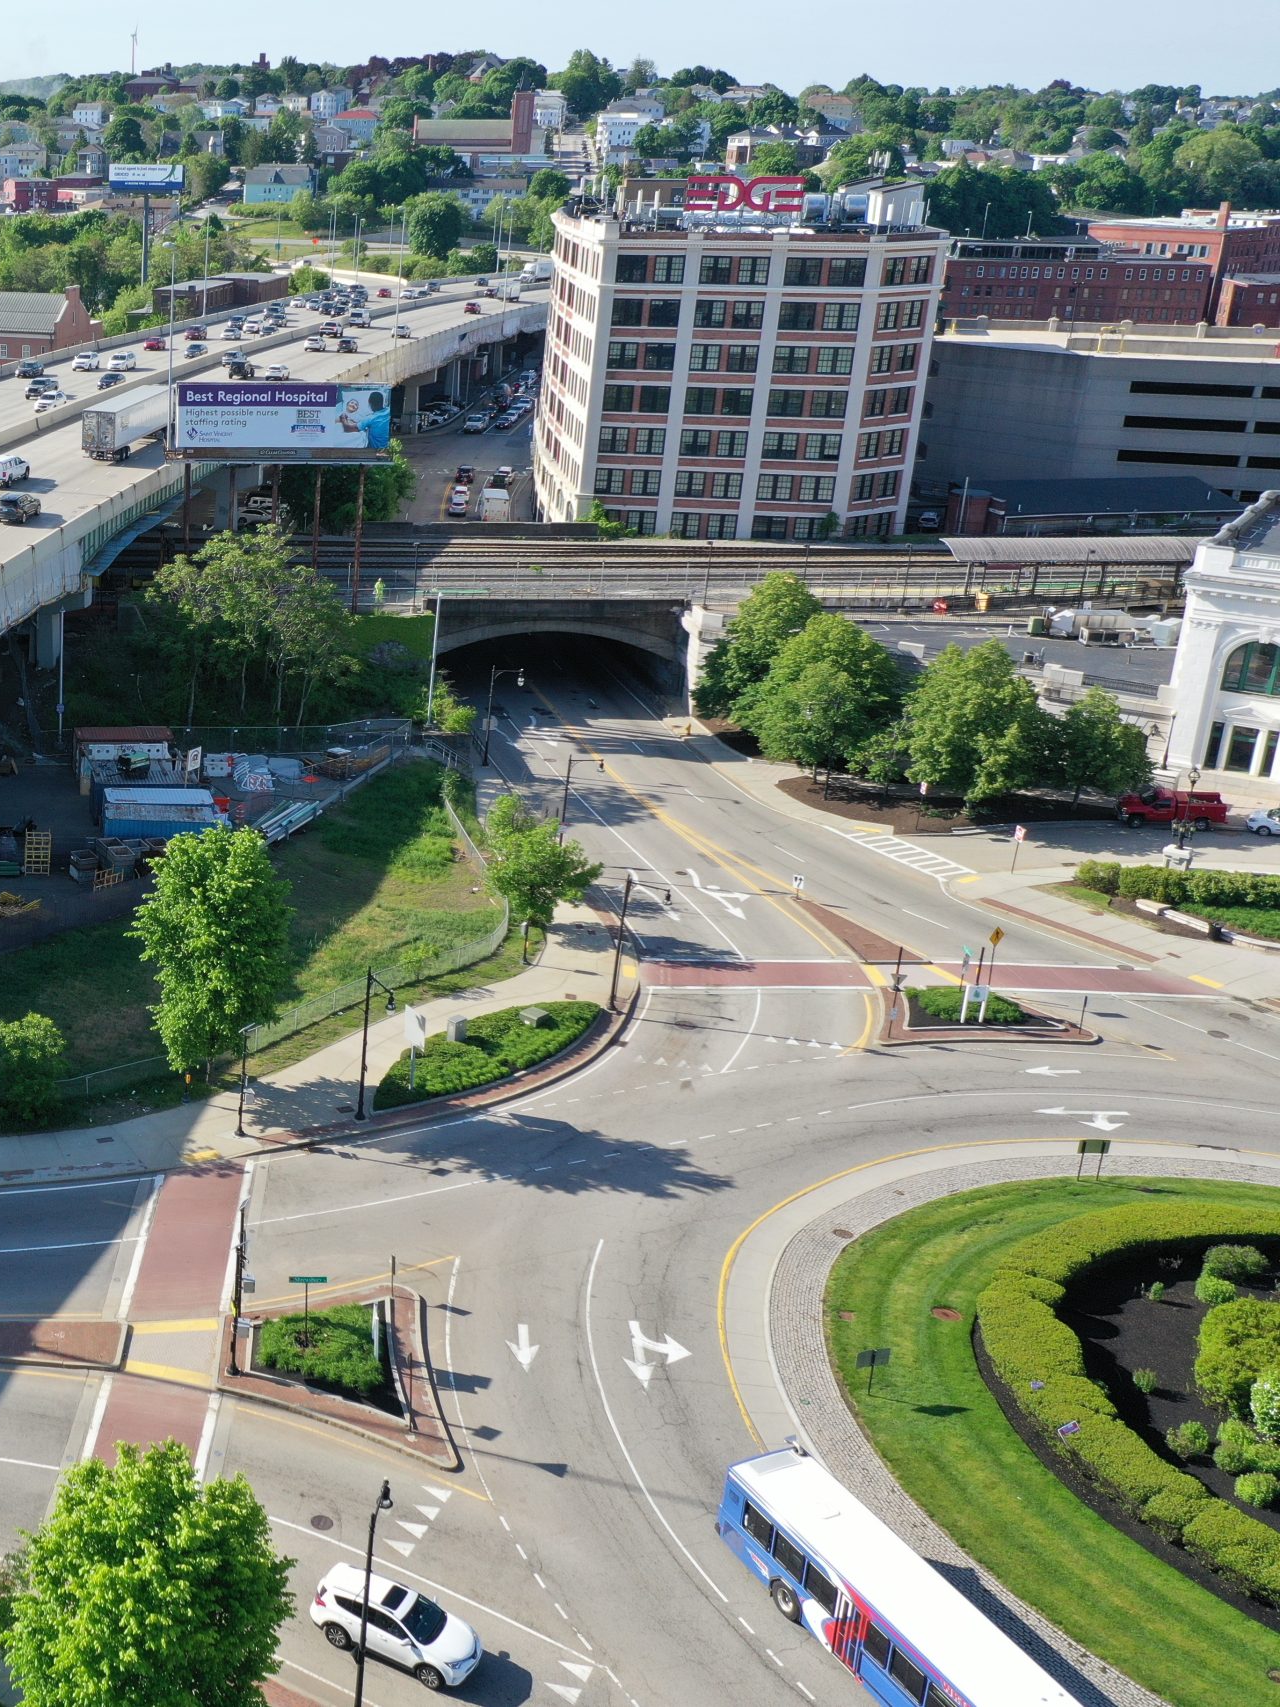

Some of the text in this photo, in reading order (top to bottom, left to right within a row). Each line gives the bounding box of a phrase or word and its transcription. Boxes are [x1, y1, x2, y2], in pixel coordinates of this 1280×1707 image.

[683, 176, 808, 212] EDGE
[186, 390, 328, 406] Best Regional Hospital
[185, 408, 218, 418] Highest
[220, 408, 253, 417] possible
[296, 409, 321, 418] BEST
[185, 419, 247, 427] staffing rating
